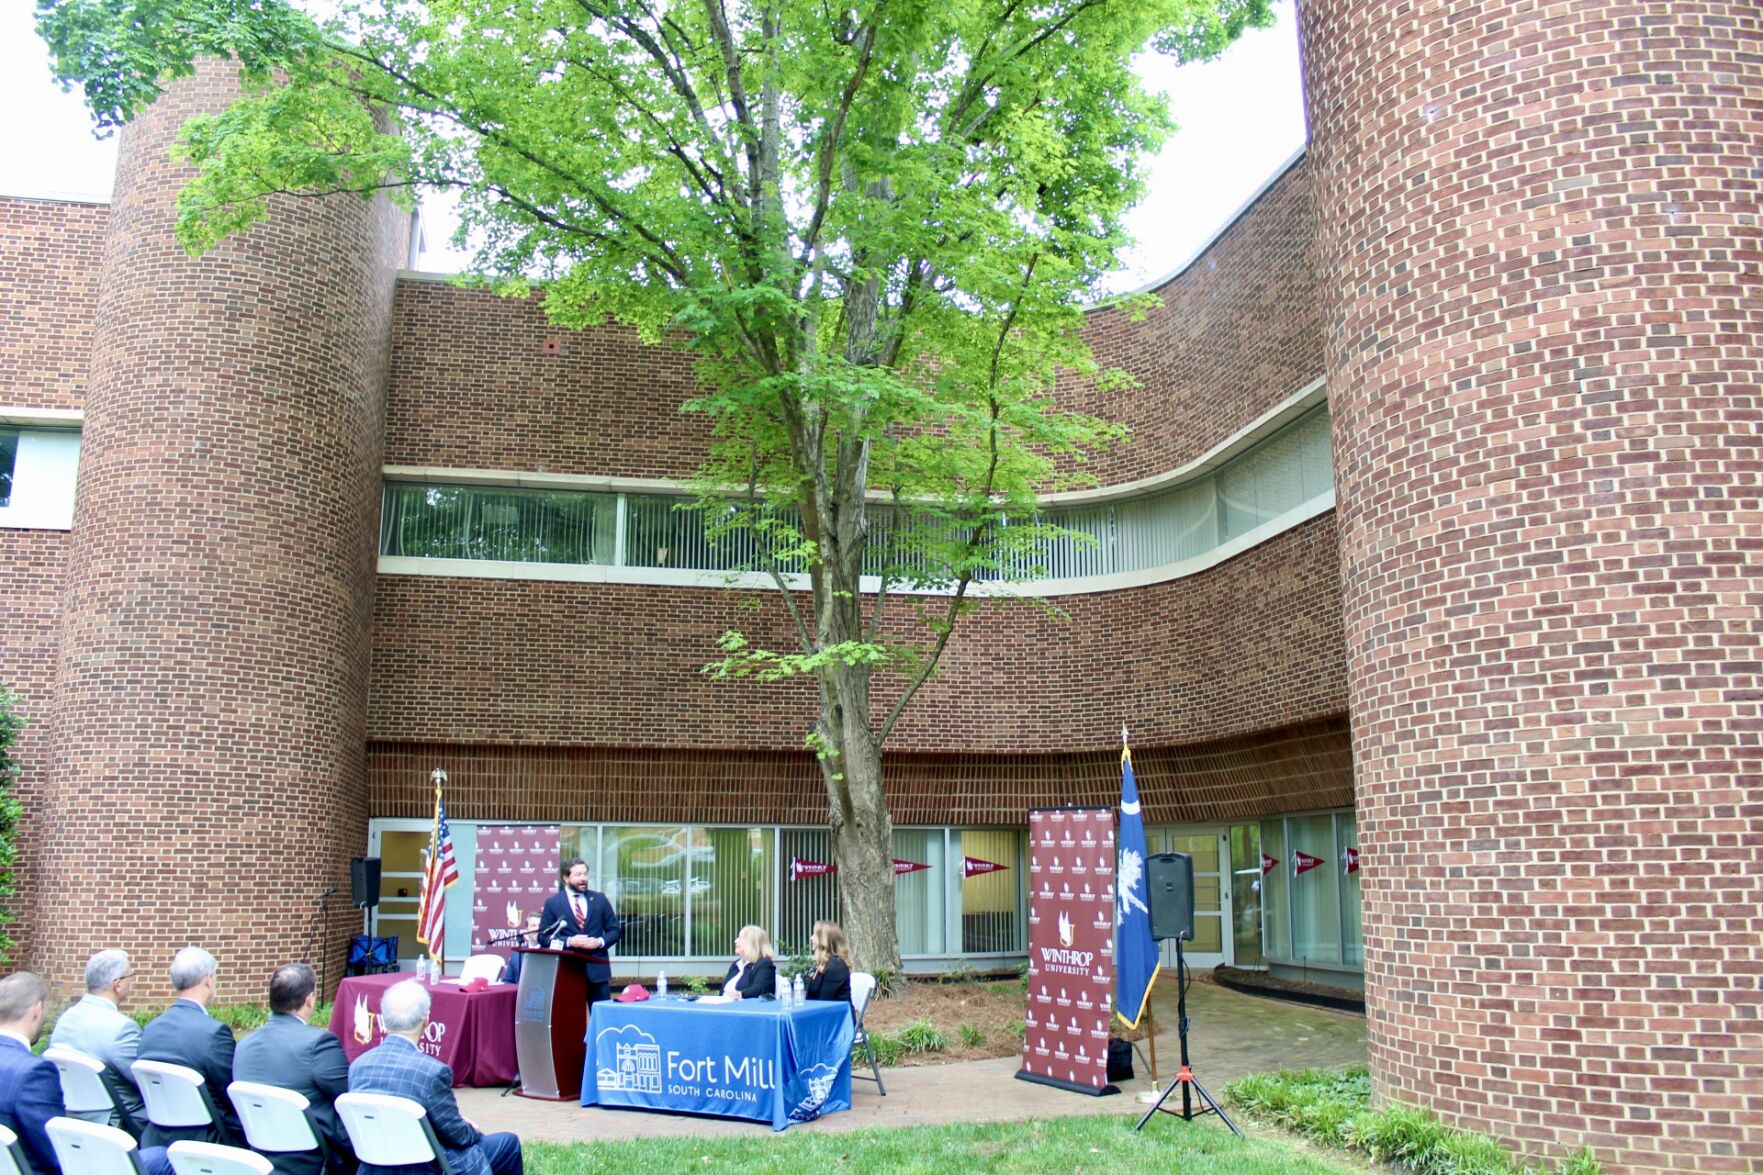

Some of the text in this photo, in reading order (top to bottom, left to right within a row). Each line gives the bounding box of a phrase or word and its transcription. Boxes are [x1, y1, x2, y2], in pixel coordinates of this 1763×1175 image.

[1040, 947, 1093, 967] WINTHROP
[1045, 963, 1090, 976] UNIVERSITY
[667, 1050, 776, 1090] Fort Mill
[667, 1084, 757, 1103] SOUTH CAROLINA
